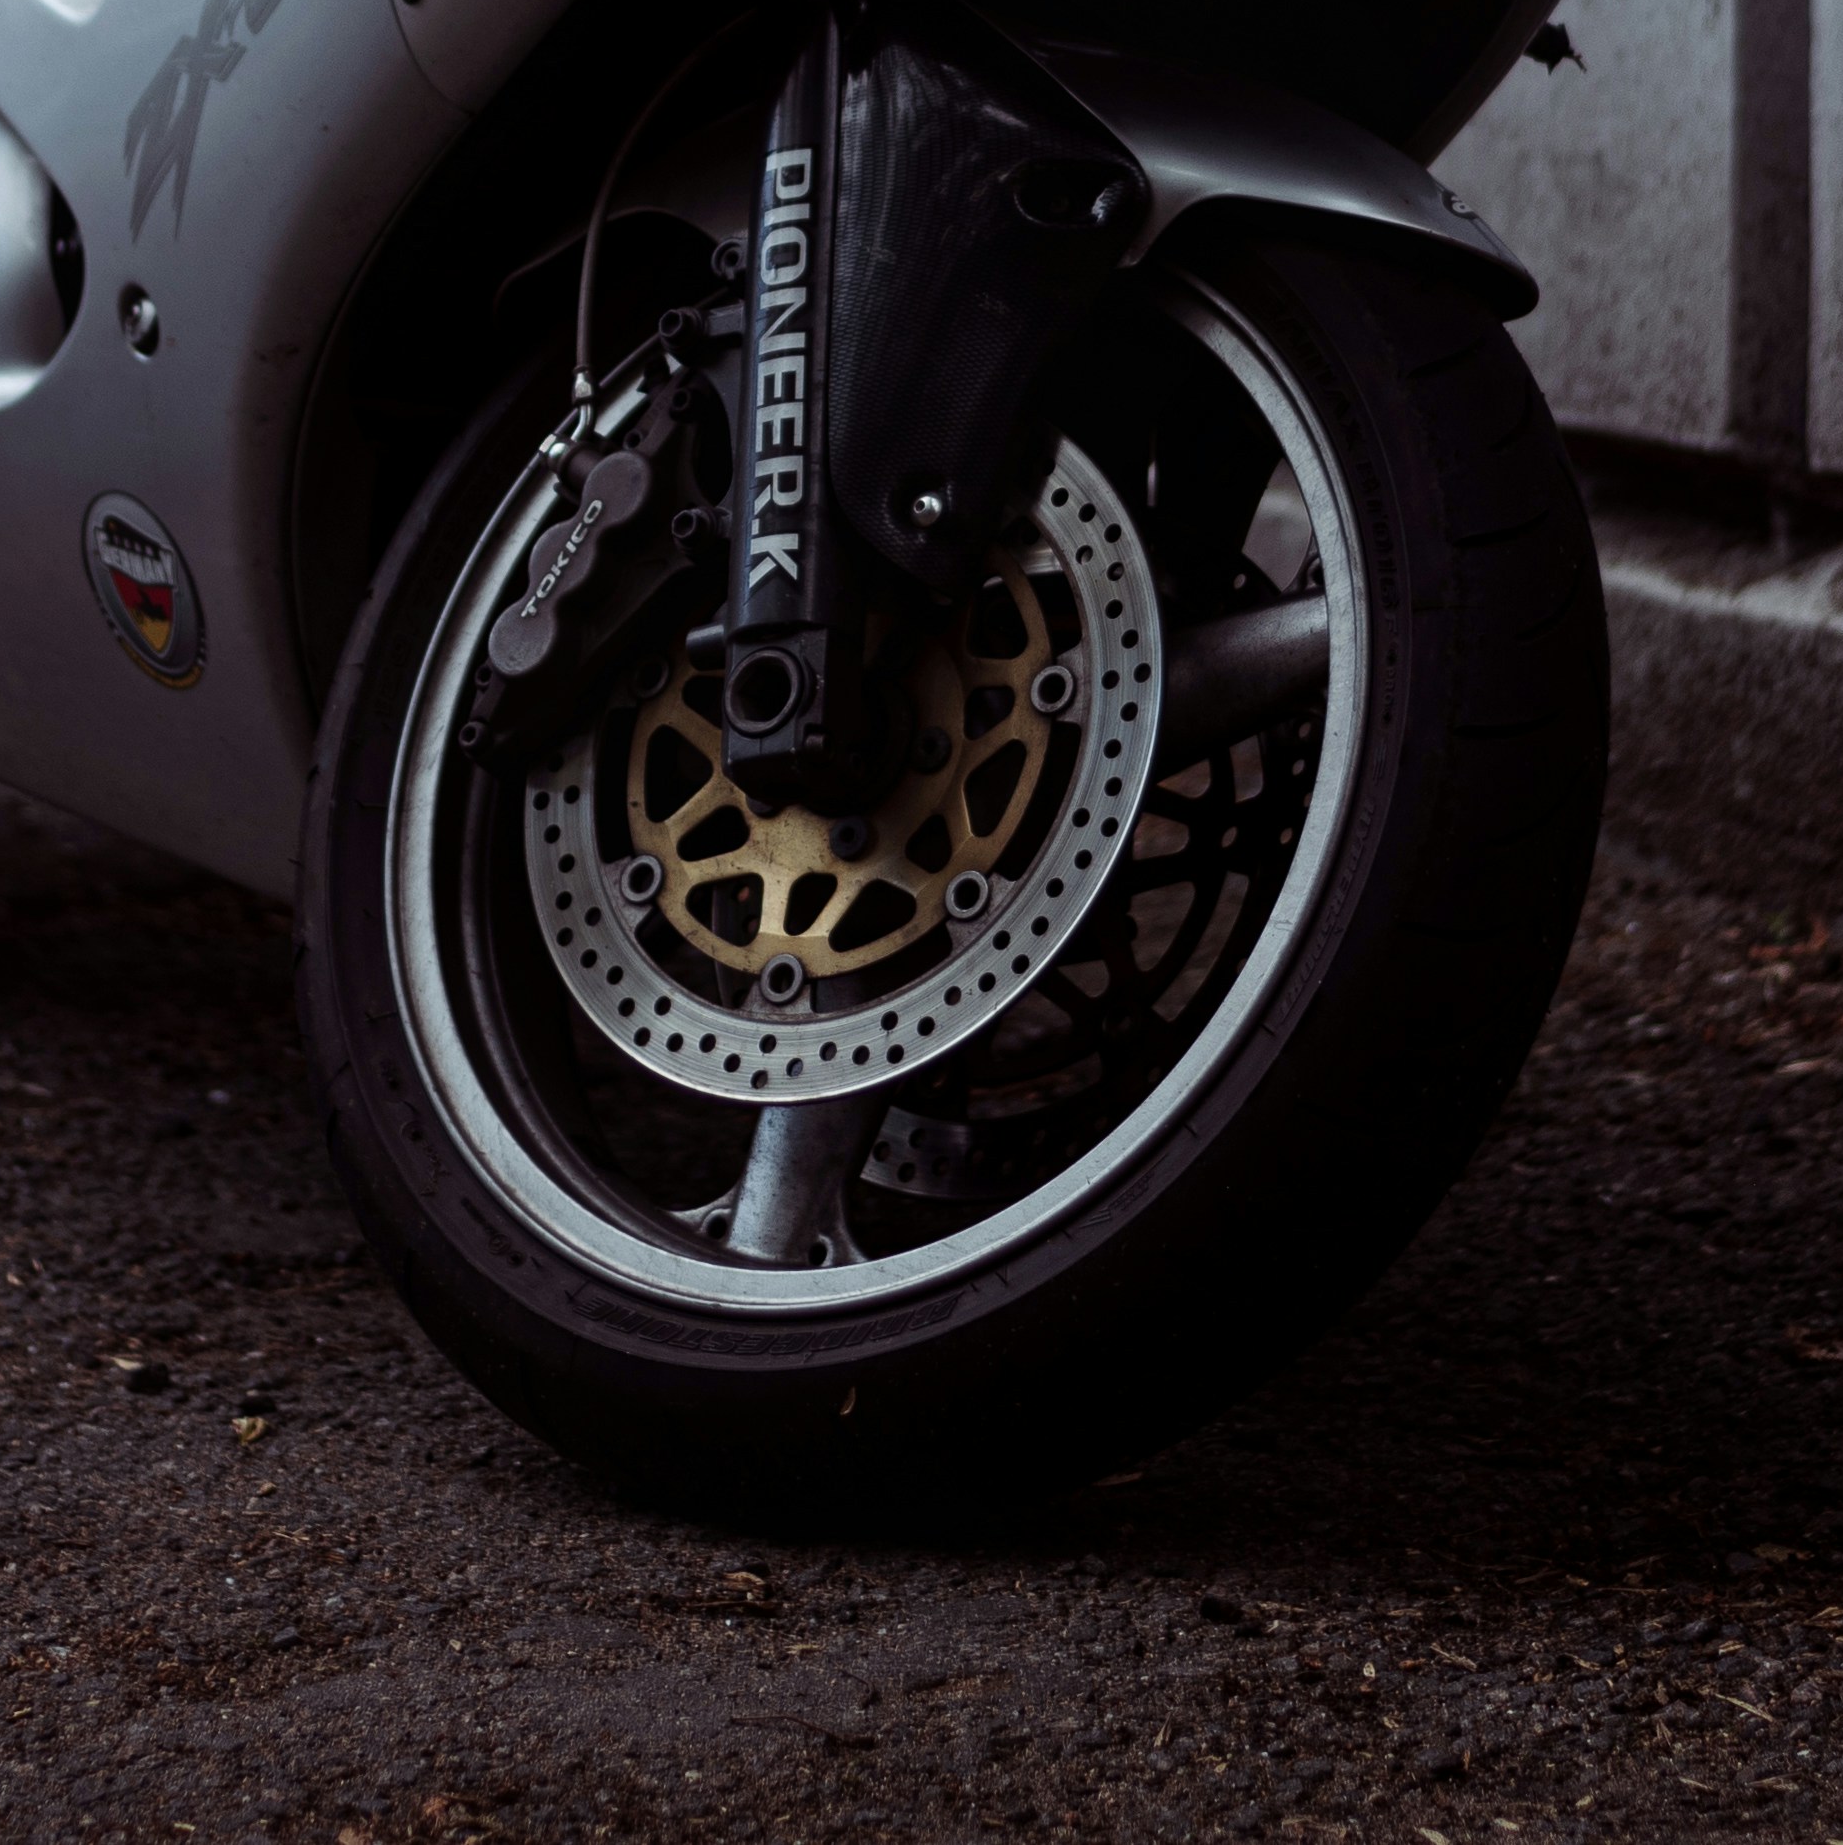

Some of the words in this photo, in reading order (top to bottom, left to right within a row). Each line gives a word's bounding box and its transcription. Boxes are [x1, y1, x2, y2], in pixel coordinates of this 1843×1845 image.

[748, 147, 813, 589] PIONEER.K
[519, 498, 603, 618] TOKICO
[571, 1289, 965, 1355] BRIDGESTONE
